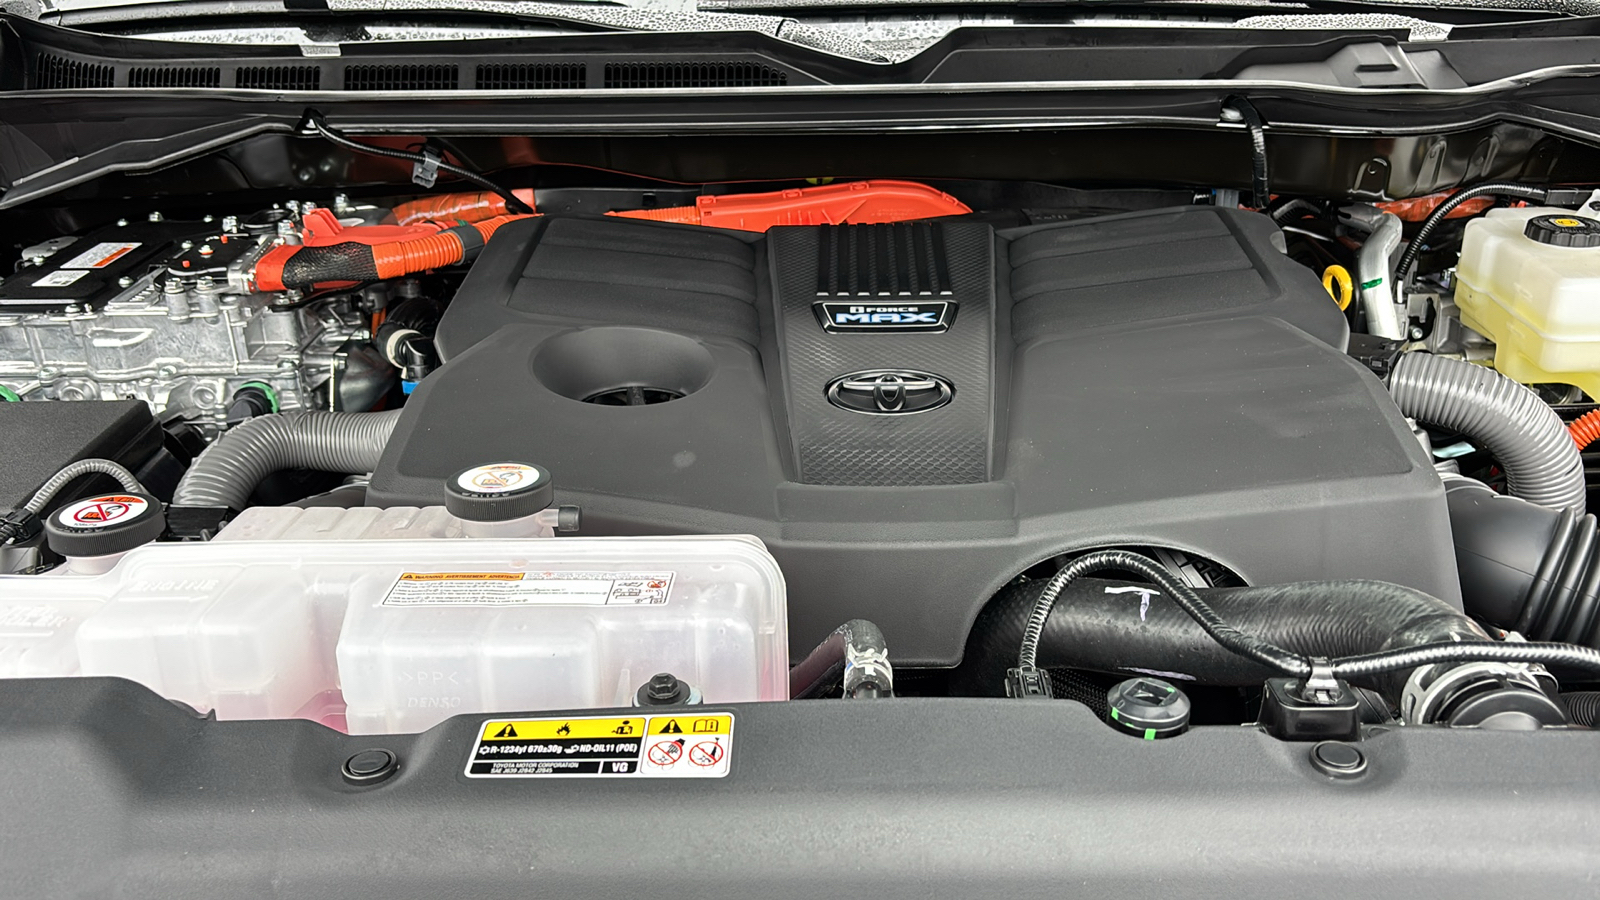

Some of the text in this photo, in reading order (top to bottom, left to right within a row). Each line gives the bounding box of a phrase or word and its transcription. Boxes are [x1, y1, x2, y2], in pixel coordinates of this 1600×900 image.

[835, 312, 937, 323] MAX
[407, 696, 461, 709] DENSO
[490, 744, 527, 755] R-1234yf
[580, 743, 614, 753] ND-OIL11
[615, 743, 638, 754] (POE)
[612, 762, 629, 772] VG
